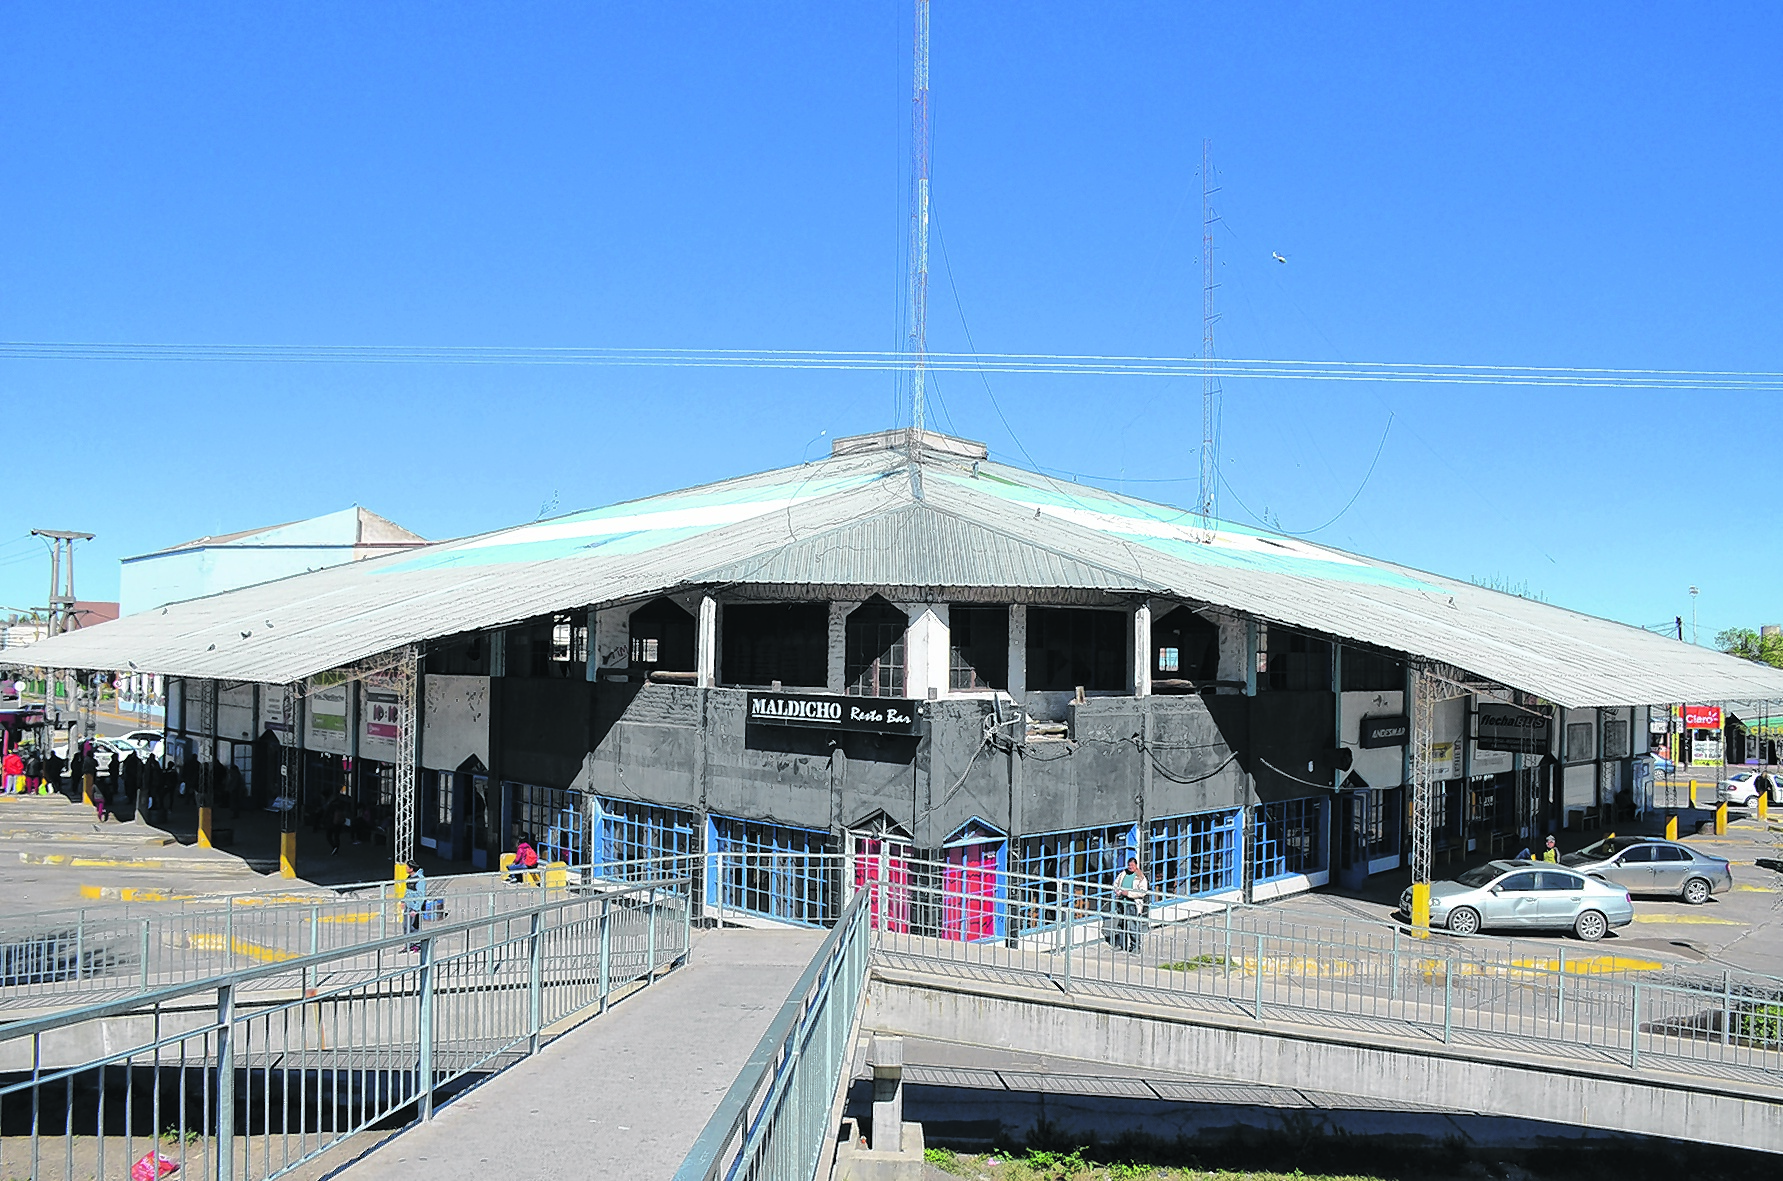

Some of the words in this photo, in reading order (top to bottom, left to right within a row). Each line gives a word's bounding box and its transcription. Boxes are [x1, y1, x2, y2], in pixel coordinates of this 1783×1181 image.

[752, 699, 841, 719] MALDICHO
[850, 706, 883, 722] Resto
[886, 708, 912, 724] Bar
[1686, 714, 1714, 724] Claro
